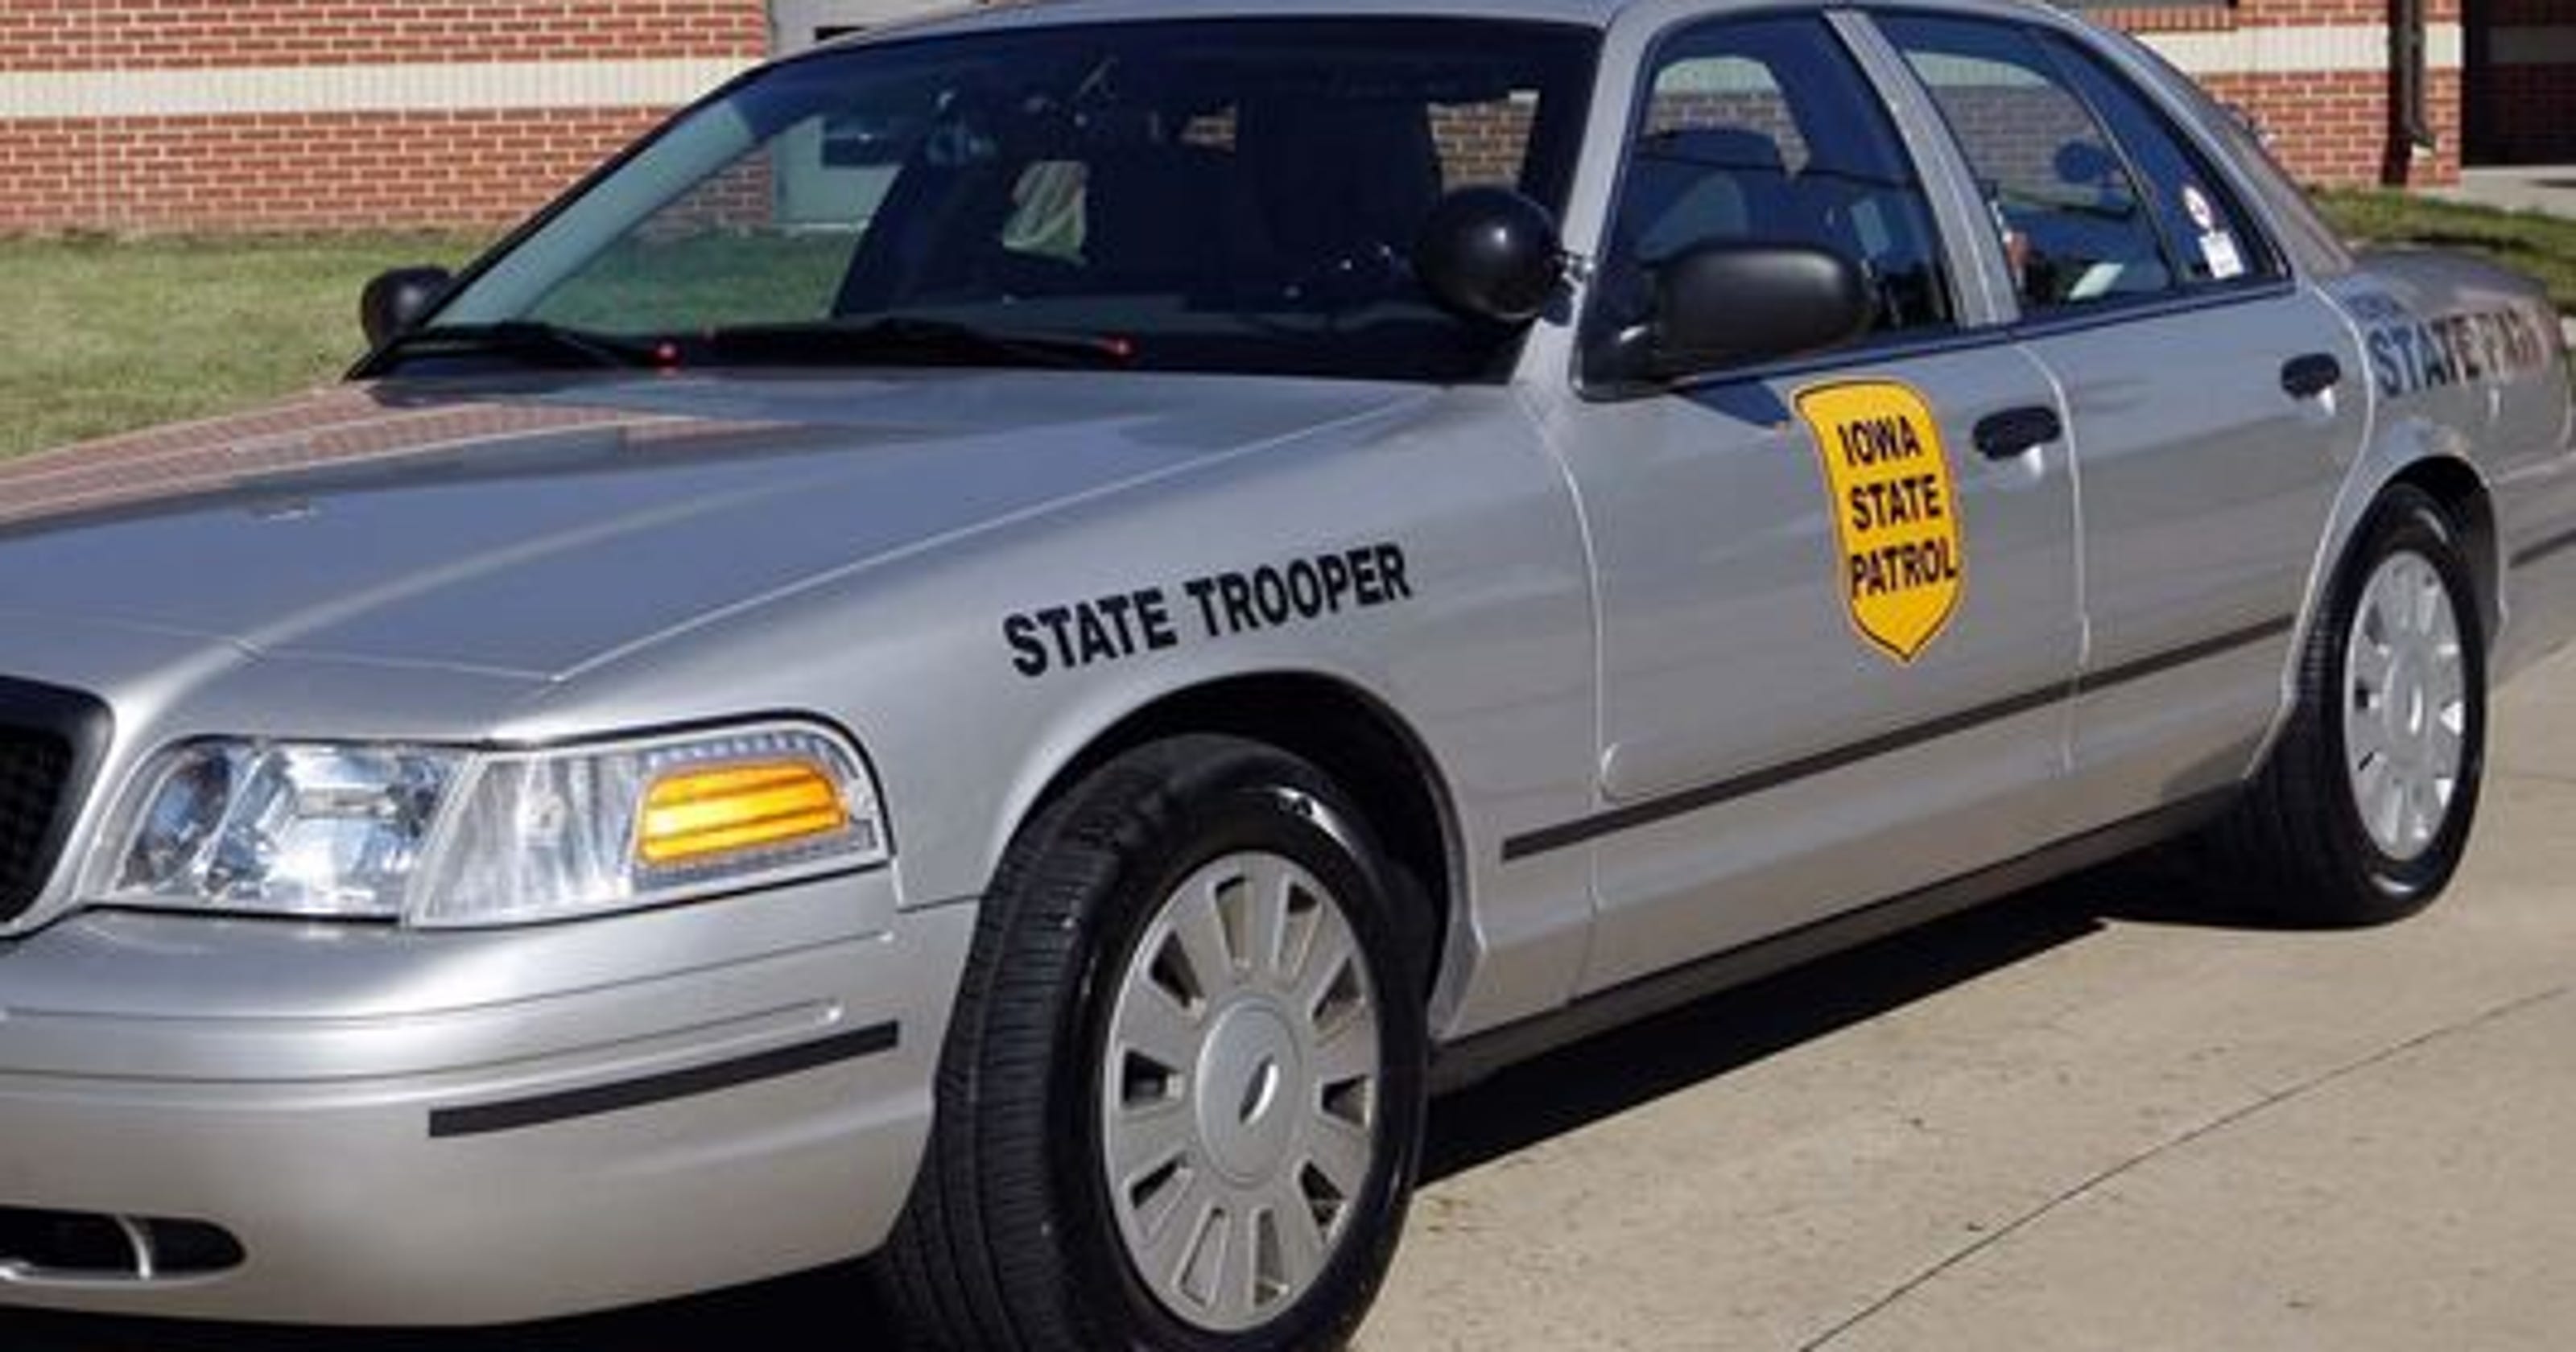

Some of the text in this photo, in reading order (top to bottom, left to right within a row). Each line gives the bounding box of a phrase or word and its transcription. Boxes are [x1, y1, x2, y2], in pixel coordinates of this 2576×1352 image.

[2368, 312, 2479, 398] STATE
[1837, 414, 1923, 466] IOWA
[1851, 474, 1942, 530] STATE
[1851, 536, 1956, 598] PATROL
[1002, 542, 1413, 677] STATE TROOPER
